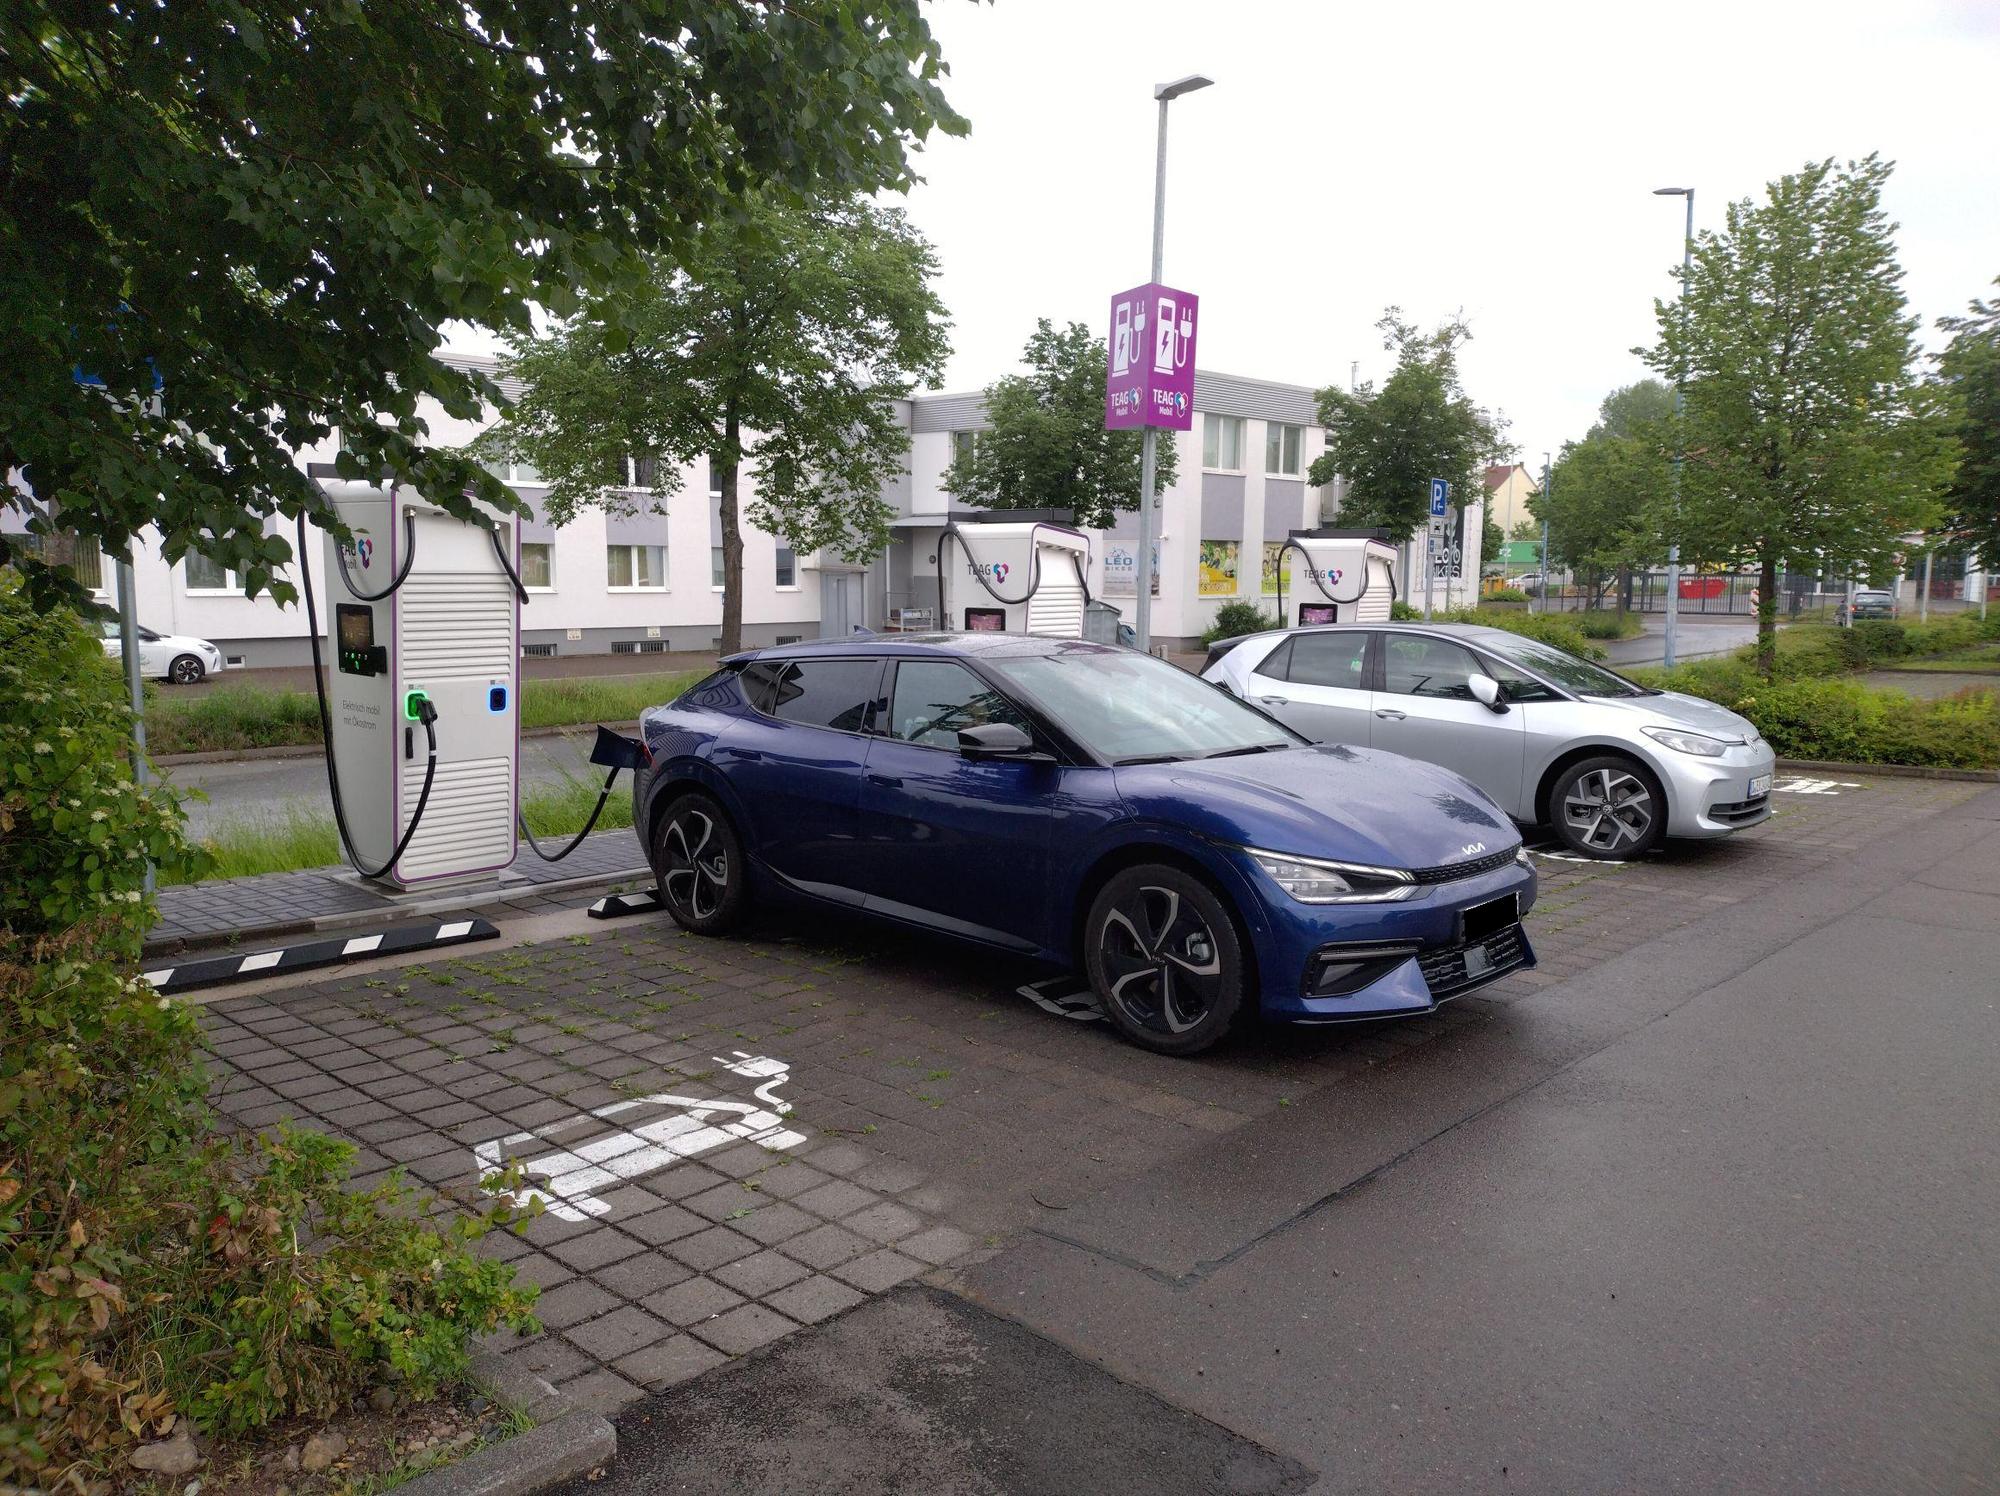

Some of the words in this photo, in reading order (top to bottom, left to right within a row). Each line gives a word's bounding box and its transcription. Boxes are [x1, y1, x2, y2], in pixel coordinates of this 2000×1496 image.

[1111, 391, 1129, 407] TEAG
[1153, 389, 1174, 405] TEAG
[1159, 406, 1173, 416] Mobil
[1433, 484, 1442, 510] P
[1105, 557, 1132, 565] LEO
